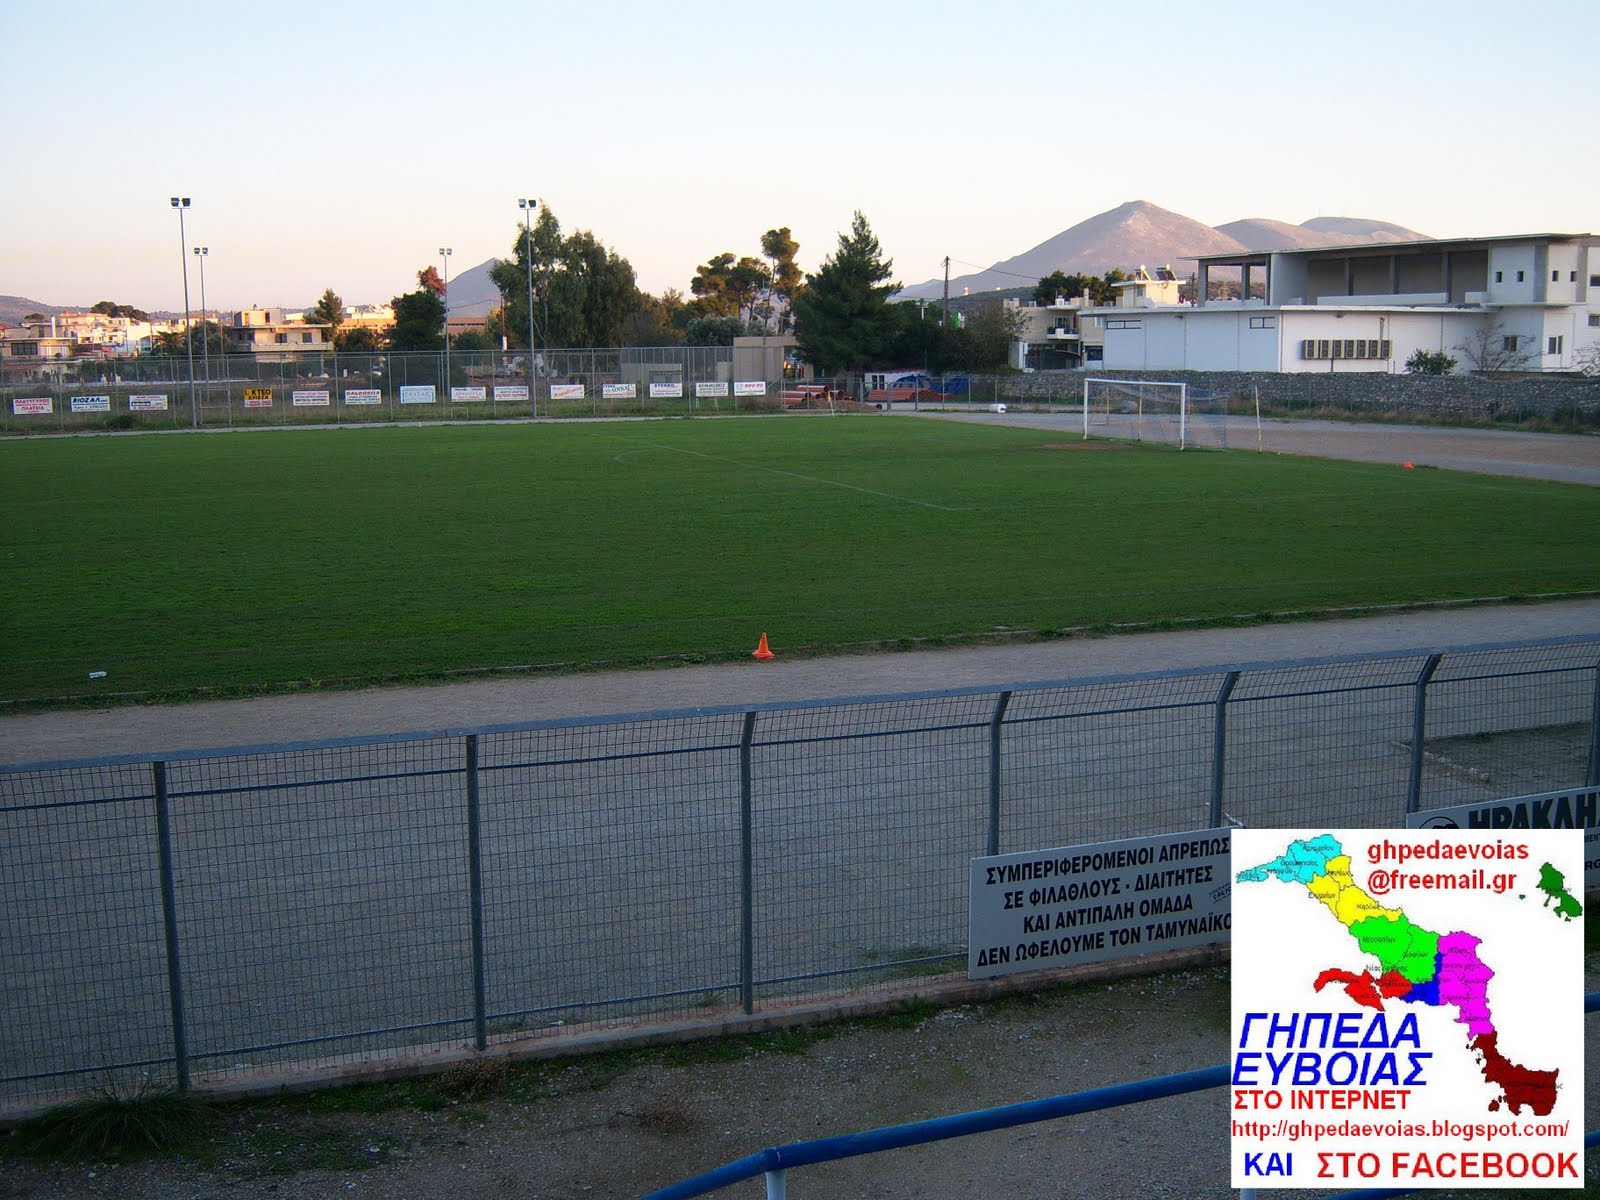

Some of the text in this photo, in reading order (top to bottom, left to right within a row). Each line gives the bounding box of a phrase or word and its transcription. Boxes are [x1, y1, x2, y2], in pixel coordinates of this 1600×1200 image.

[1469, 791, 1600, 829] ΗΡΑΚΛΗ
[986, 836, 1230, 885] ΣΥΜΠΕΡΙΦΕΡΟΜΕΝΟΙ ΑΠΡΕΠΩΣ
[1003, 890, 1024, 910] ΣΕ
[1029, 877, 1121, 906] ΦΙΛΑΘΛΟΥΣ
[1134, 865, 1213, 892] ΔΙΑΙΤΗΤΕΣ
[1023, 893, 1193, 934] ΚΑΙ ΑΝΤΙΠΑΛΗ ΟΜΑΔΑ
[977, 945, 1010, 967] ΔΕΝ
[1015, 932, 1105, 962] ΩΦΕΛΟΥΜΕ
[1109, 925, 1141, 947] ΤΟΝ
